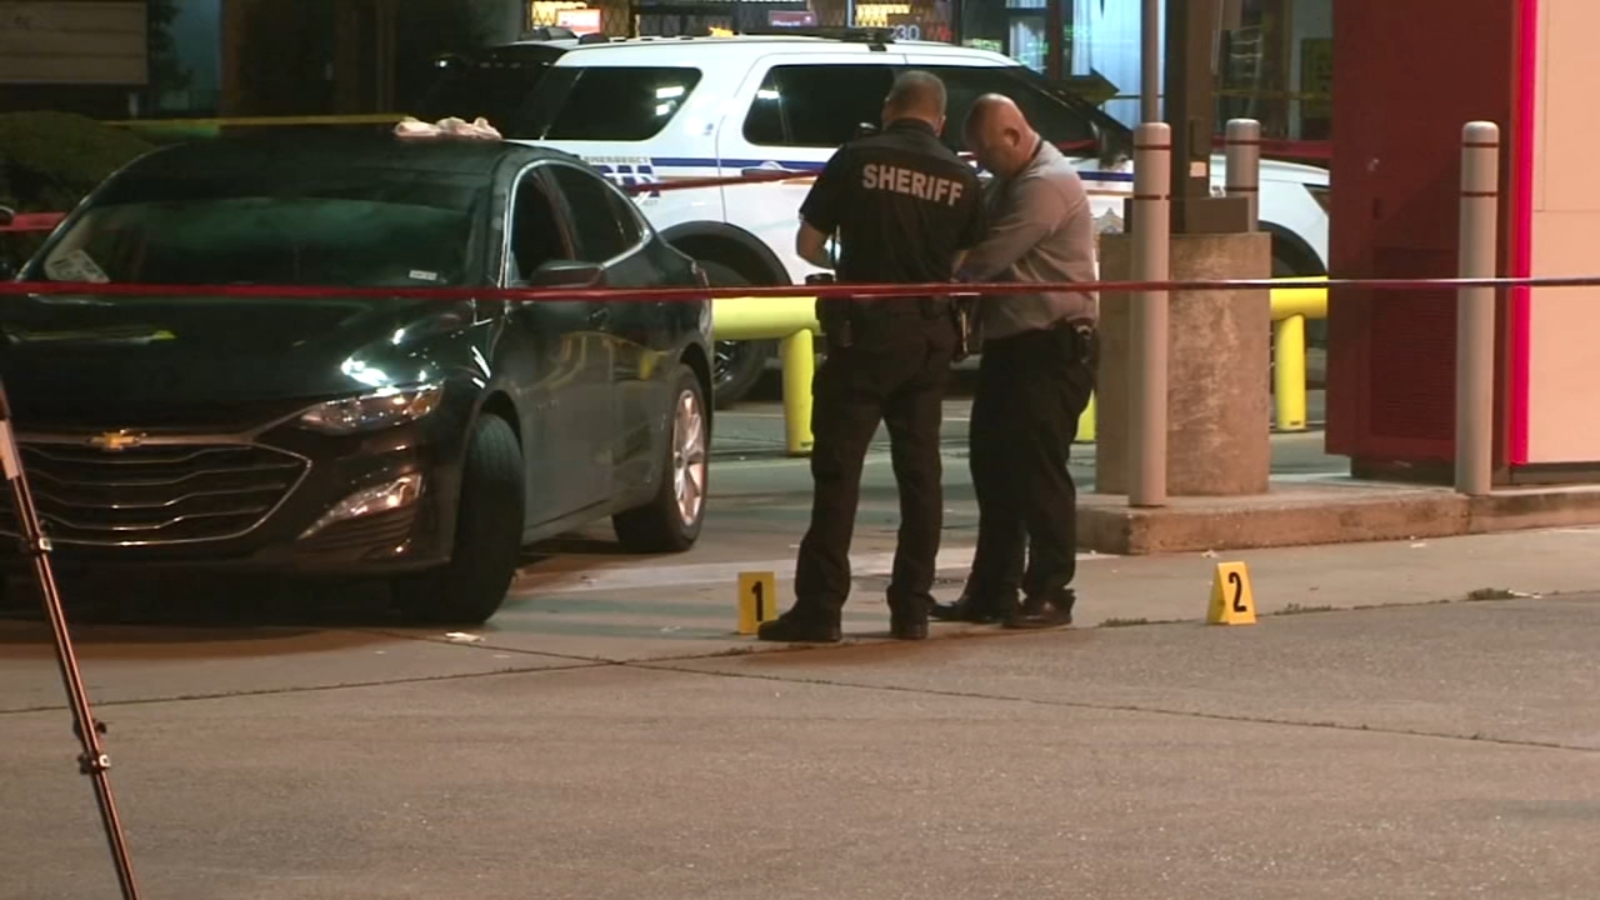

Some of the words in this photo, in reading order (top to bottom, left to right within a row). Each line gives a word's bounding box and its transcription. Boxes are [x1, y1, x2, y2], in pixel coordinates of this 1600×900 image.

[862, 163, 964, 206] SHERIFF
[751, 580, 763, 622] 1
[1228, 572, 1248, 612] 2
